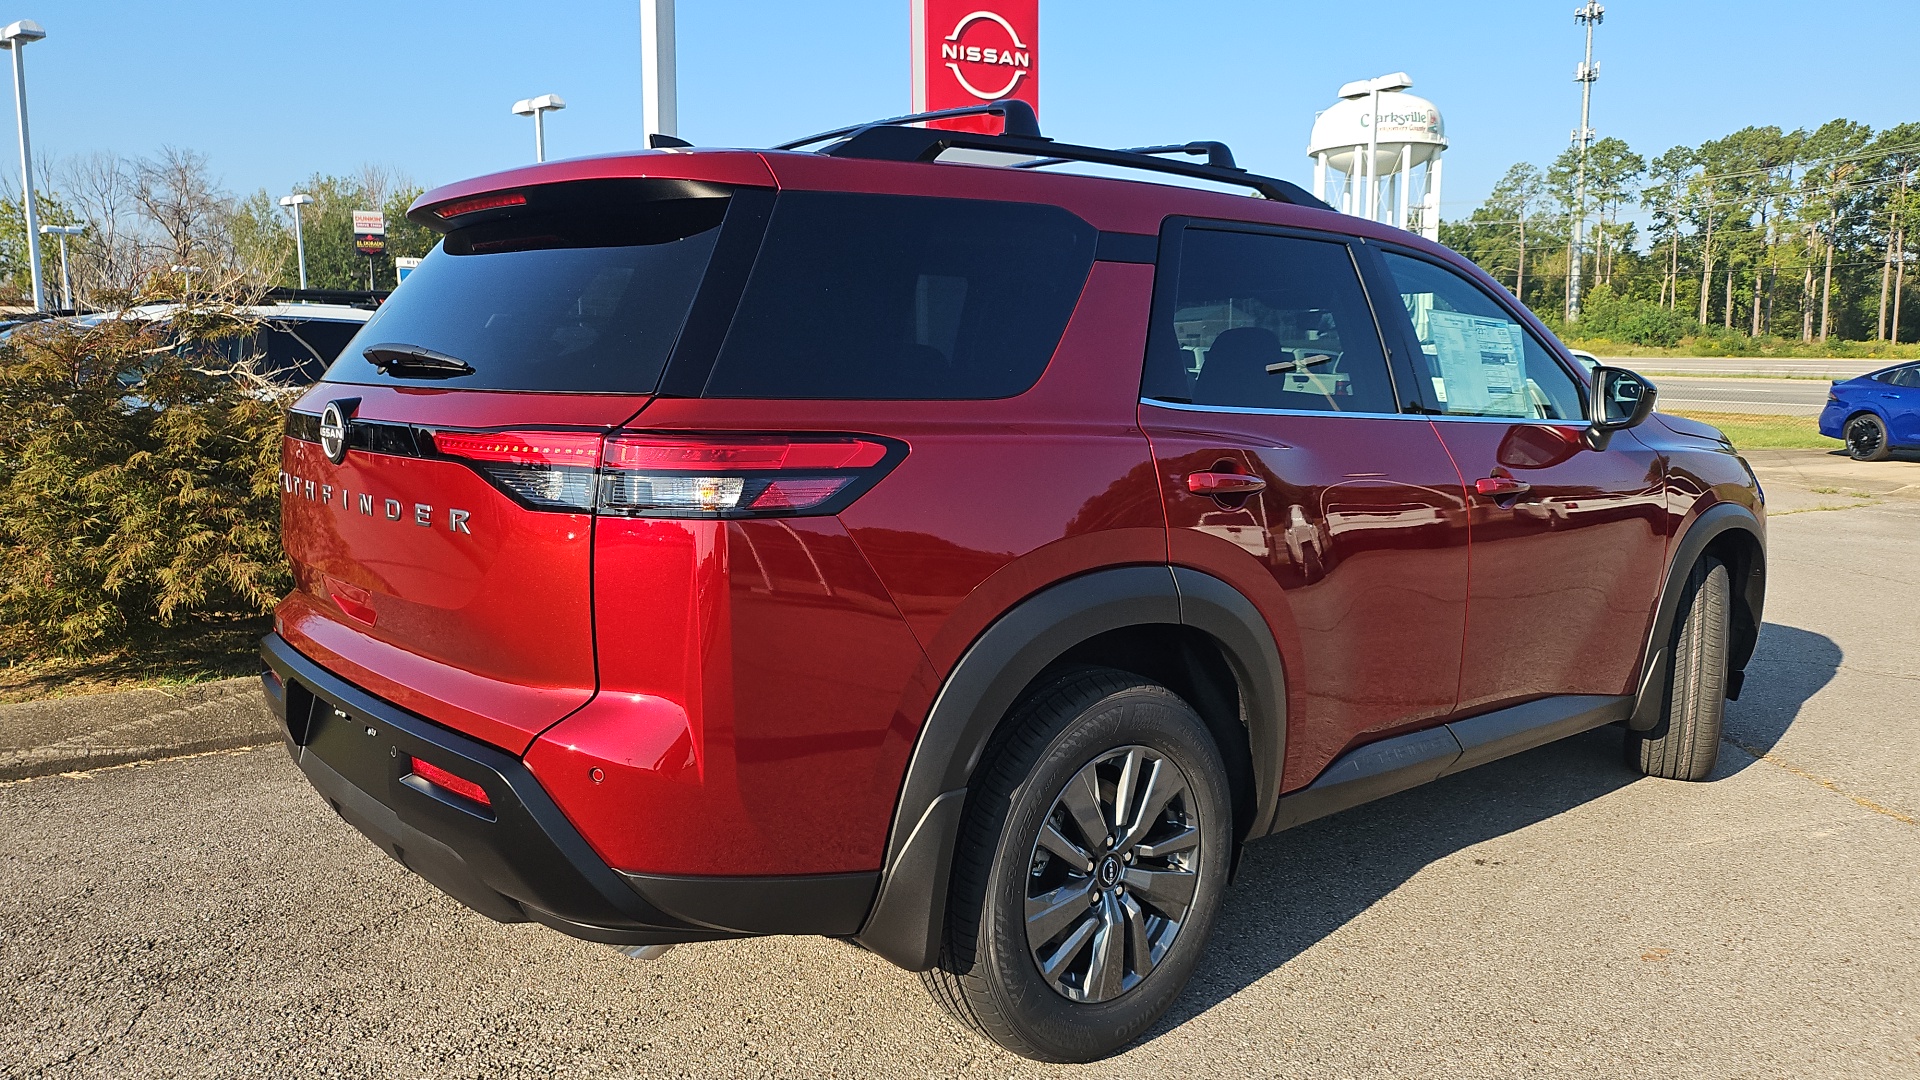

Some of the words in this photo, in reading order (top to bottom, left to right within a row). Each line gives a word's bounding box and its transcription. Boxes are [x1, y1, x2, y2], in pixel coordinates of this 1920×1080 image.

[941, 43, 1029, 67] NISSAN
[1361, 112, 1426, 127] Carksville
[320, 427, 343, 439] ISSAN
